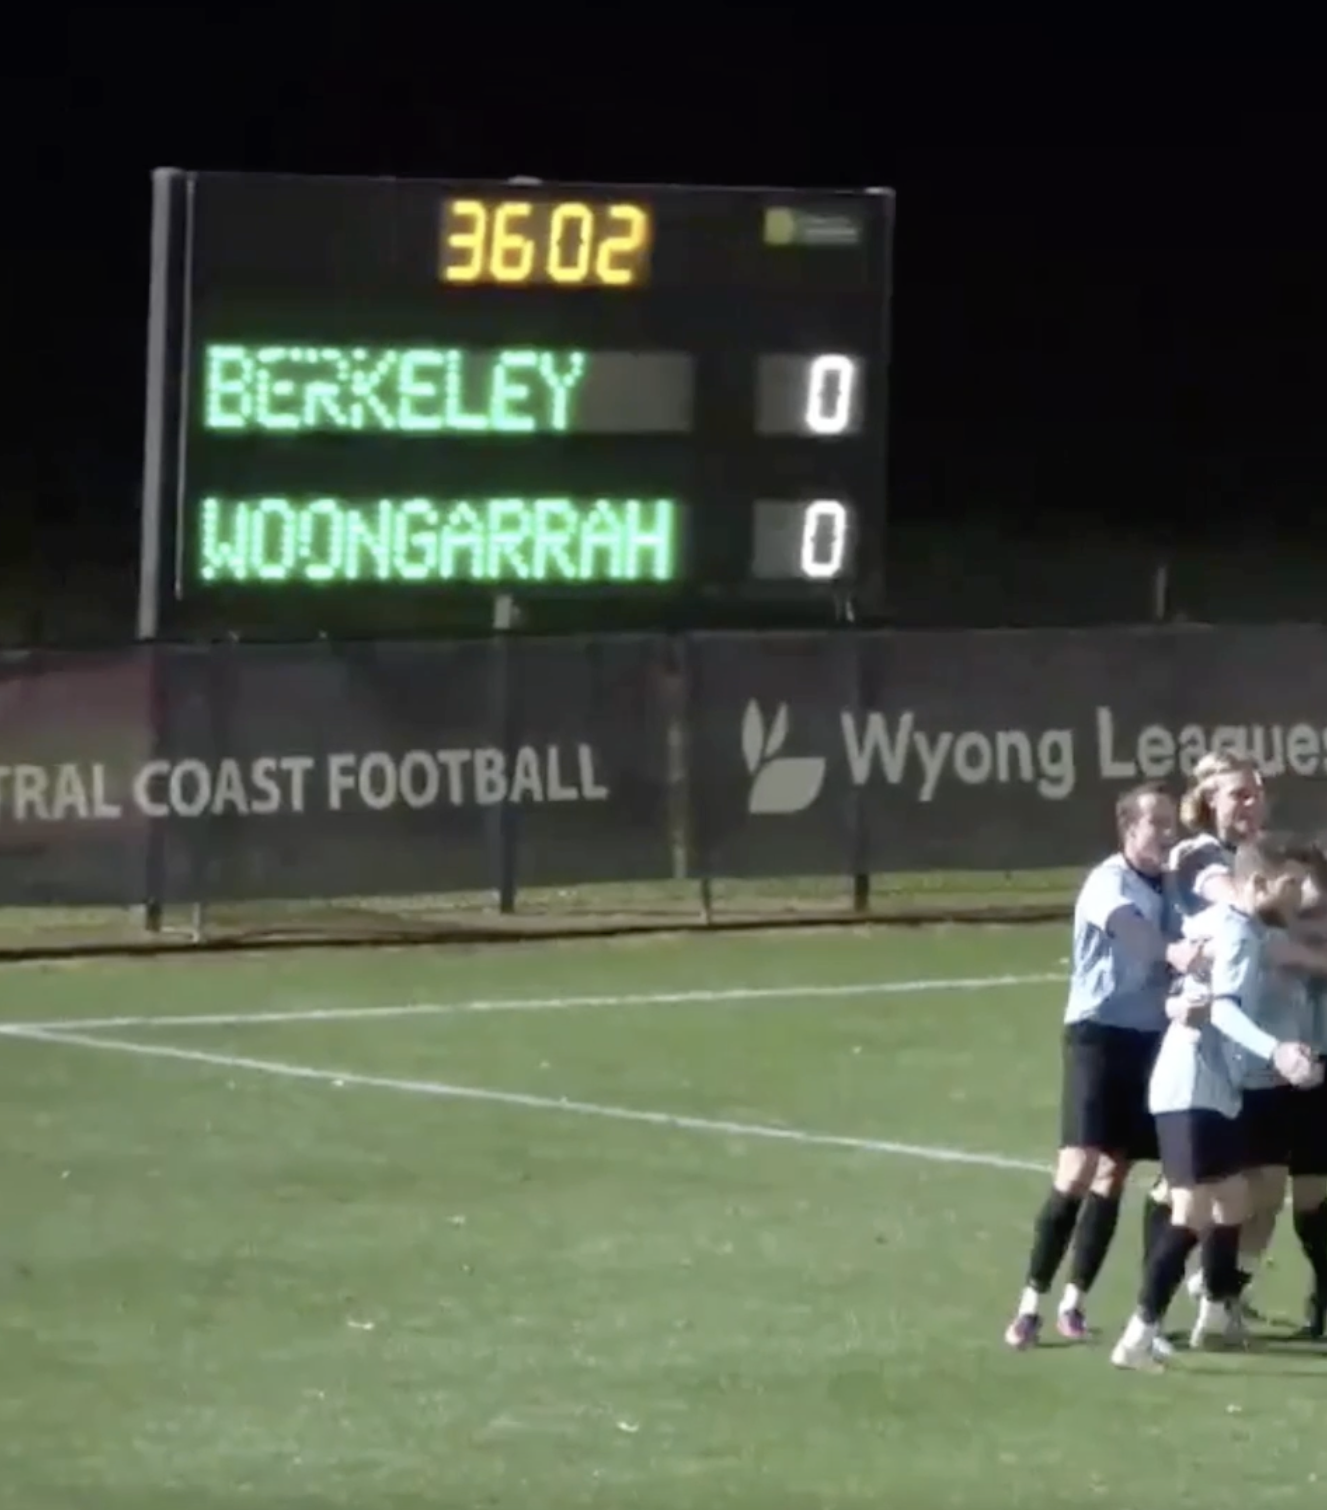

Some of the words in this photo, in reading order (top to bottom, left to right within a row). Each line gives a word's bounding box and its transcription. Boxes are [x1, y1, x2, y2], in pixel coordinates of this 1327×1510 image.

[204, 346, 587, 434] BERKELEY
[804, 352, 856, 435] 0
[200, 496, 676, 584] WOONGARRAH
[800, 499, 848, 580] 0
[132, 755, 314, 817] COAST
[328, 744, 608, 810] FOOTBALL
[842, 711, 1075, 803] Wyong
